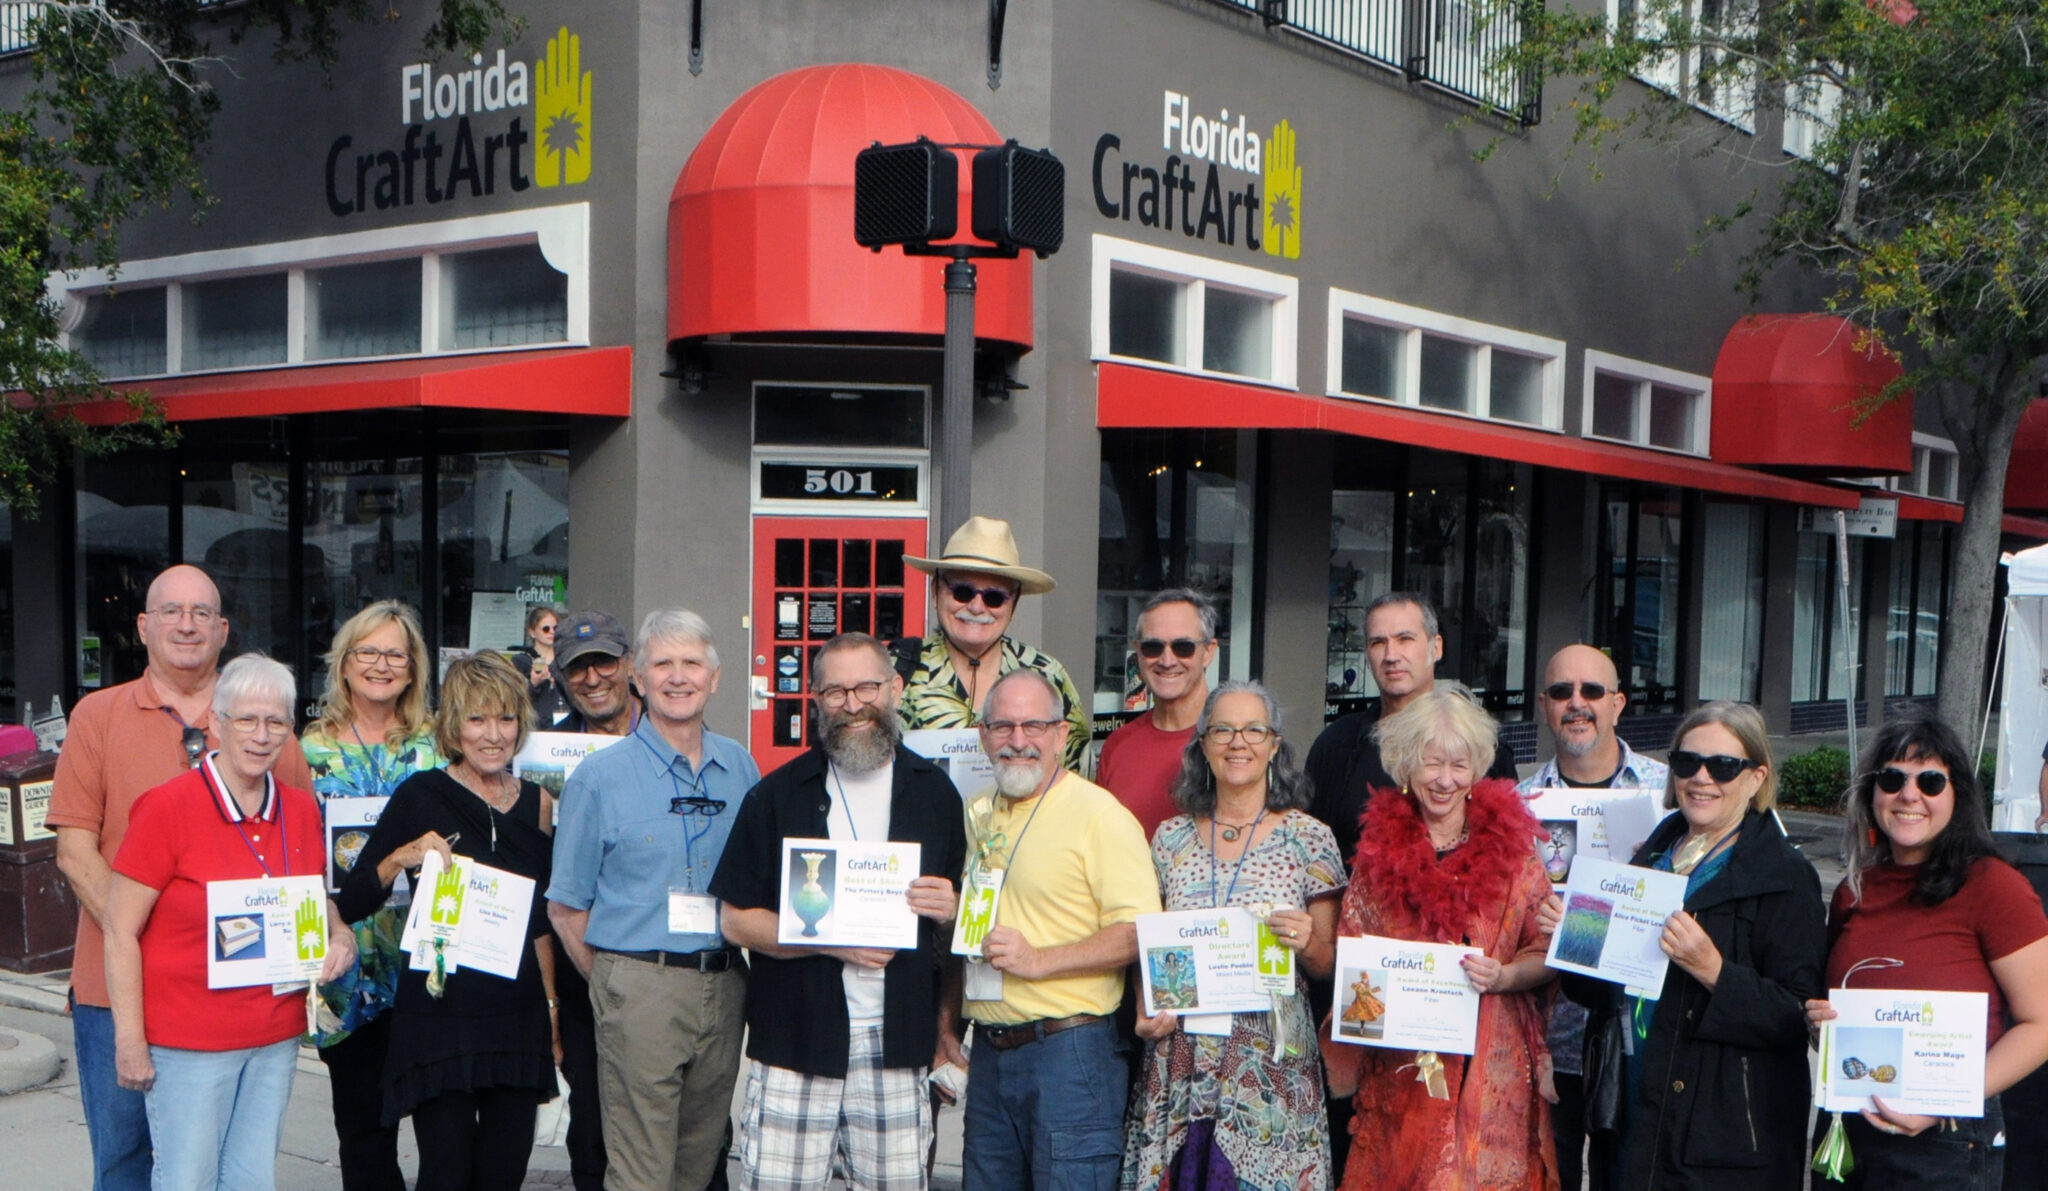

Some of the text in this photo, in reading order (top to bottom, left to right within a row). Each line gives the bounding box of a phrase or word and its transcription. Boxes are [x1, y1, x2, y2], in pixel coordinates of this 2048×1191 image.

[402, 48, 529, 125] Florida
[1163, 89, 1261, 175] Florida
[325, 115, 530, 218] CraftArt
[1092, 132, 1261, 251] CraftArt
[803, 468, 877, 494] 501
[515, 586, 554, 602] CraftArt
[305, 702, 322, 718] cla
[1325, 701, 1340, 715] ber
[1091, 715, 1126, 732] ewelry
[551, 746, 585, 757] CraftArt
[942, 743, 978, 753] CraftArt
[1571, 805, 1604, 816] CraftA
[848, 859, 887, 871] CraftArt
[469, 879, 489, 893] ftArt
[1600, 879, 1634, 896] CraftArt
[245, 895, 279, 907] CraftArt
[1178, 926, 1218, 938] CraftArt
[1381, 957, 1423, 970] CraftArt
[1875, 1008, 1920, 1022] CraftArt
